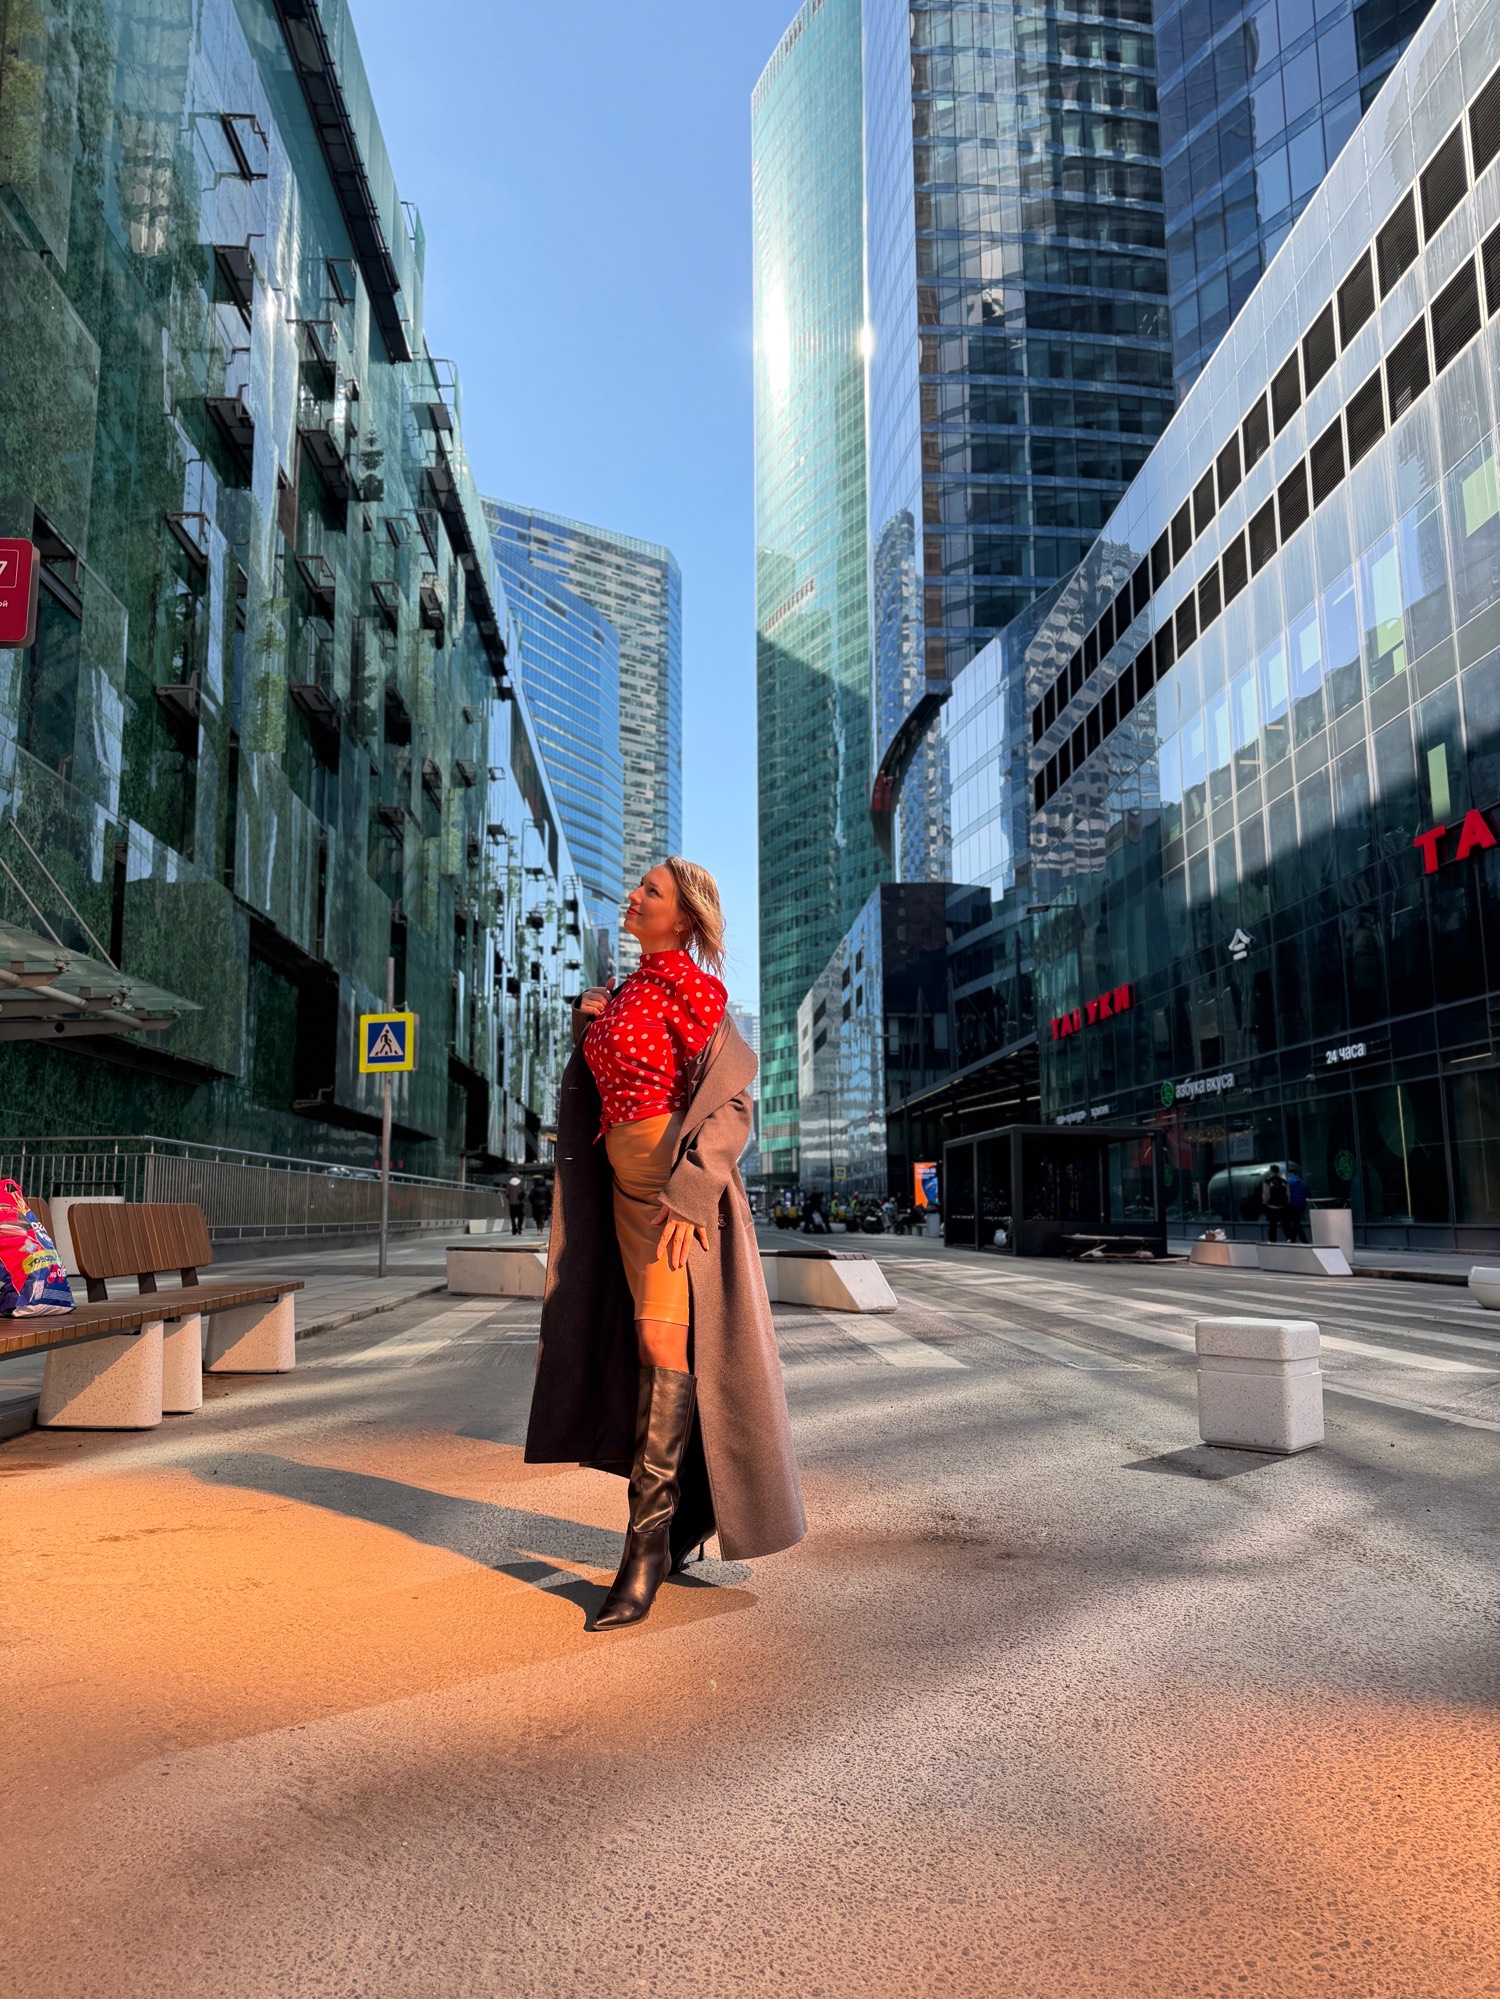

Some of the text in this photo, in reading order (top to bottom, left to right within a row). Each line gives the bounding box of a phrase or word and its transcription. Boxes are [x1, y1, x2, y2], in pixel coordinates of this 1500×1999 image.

[1412, 808, 1498, 875] ТА
[1326, 1042, 1366, 1065] 24 часа
[1175, 1072, 1235, 1101] азбука вкуса
